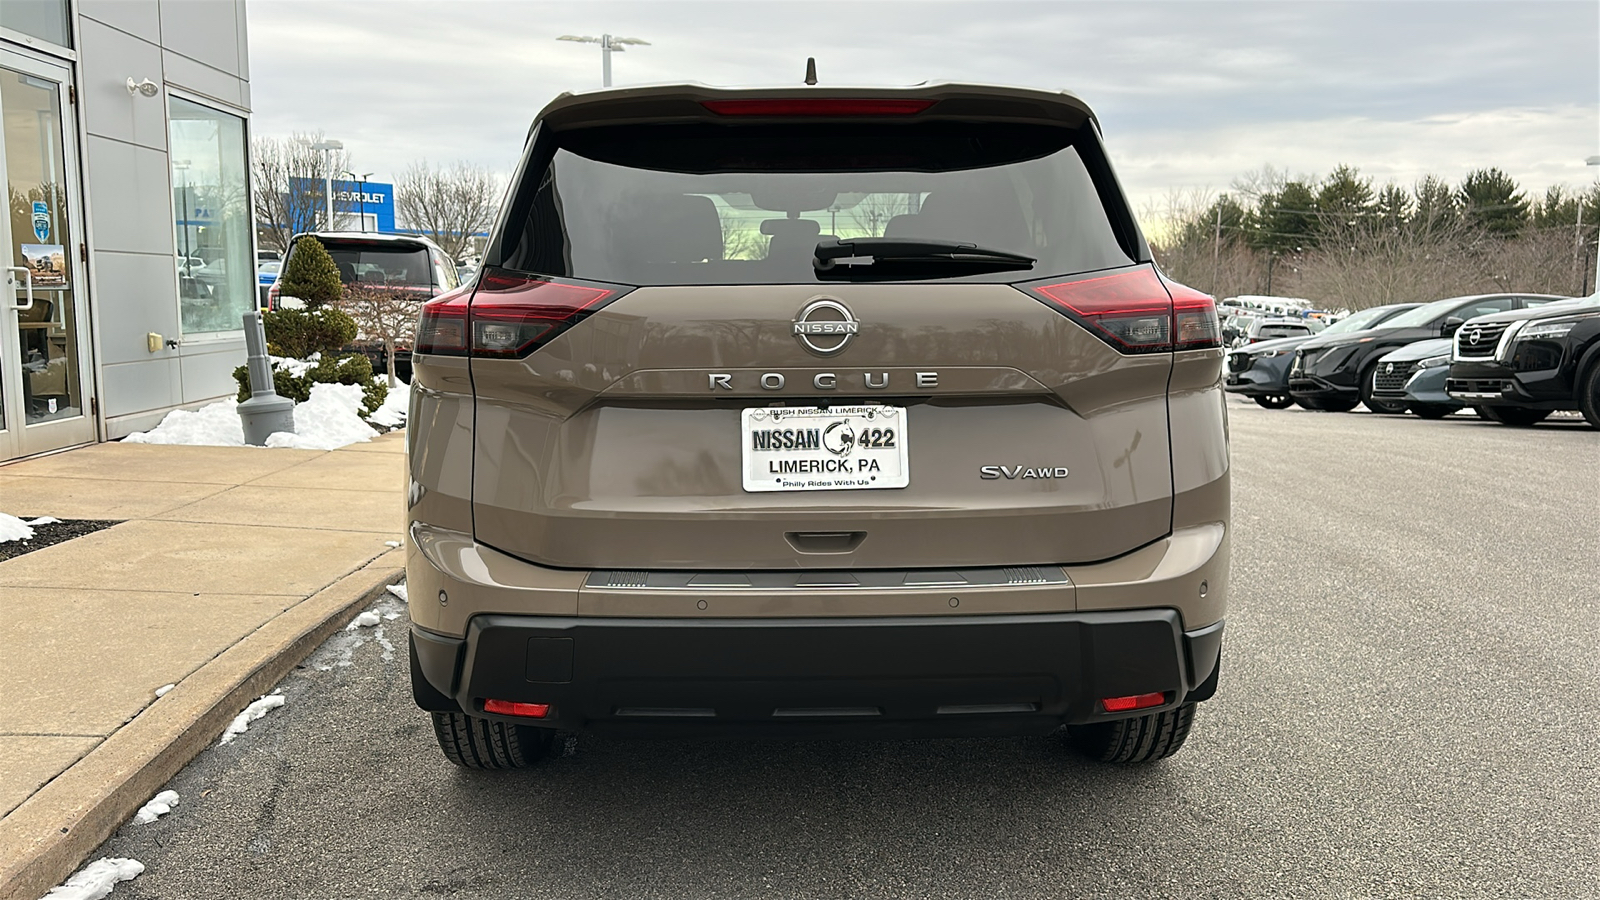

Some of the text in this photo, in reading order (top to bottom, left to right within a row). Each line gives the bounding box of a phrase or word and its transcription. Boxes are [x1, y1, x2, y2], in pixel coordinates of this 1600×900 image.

[330, 191, 385, 204] HEVROLET
[794, 324, 858, 333] NISSAN
[708, 372, 939, 390] ROGUE
[835, 406, 878, 414] LIMERICK
[753, 428, 896, 450] NISSAN 422
[769, 459, 881, 474] LIMERICK, PA
[980, 465, 1069, 479] SV AWD
[783, 479, 805, 488] Philly
[834, 479, 856, 487] With
